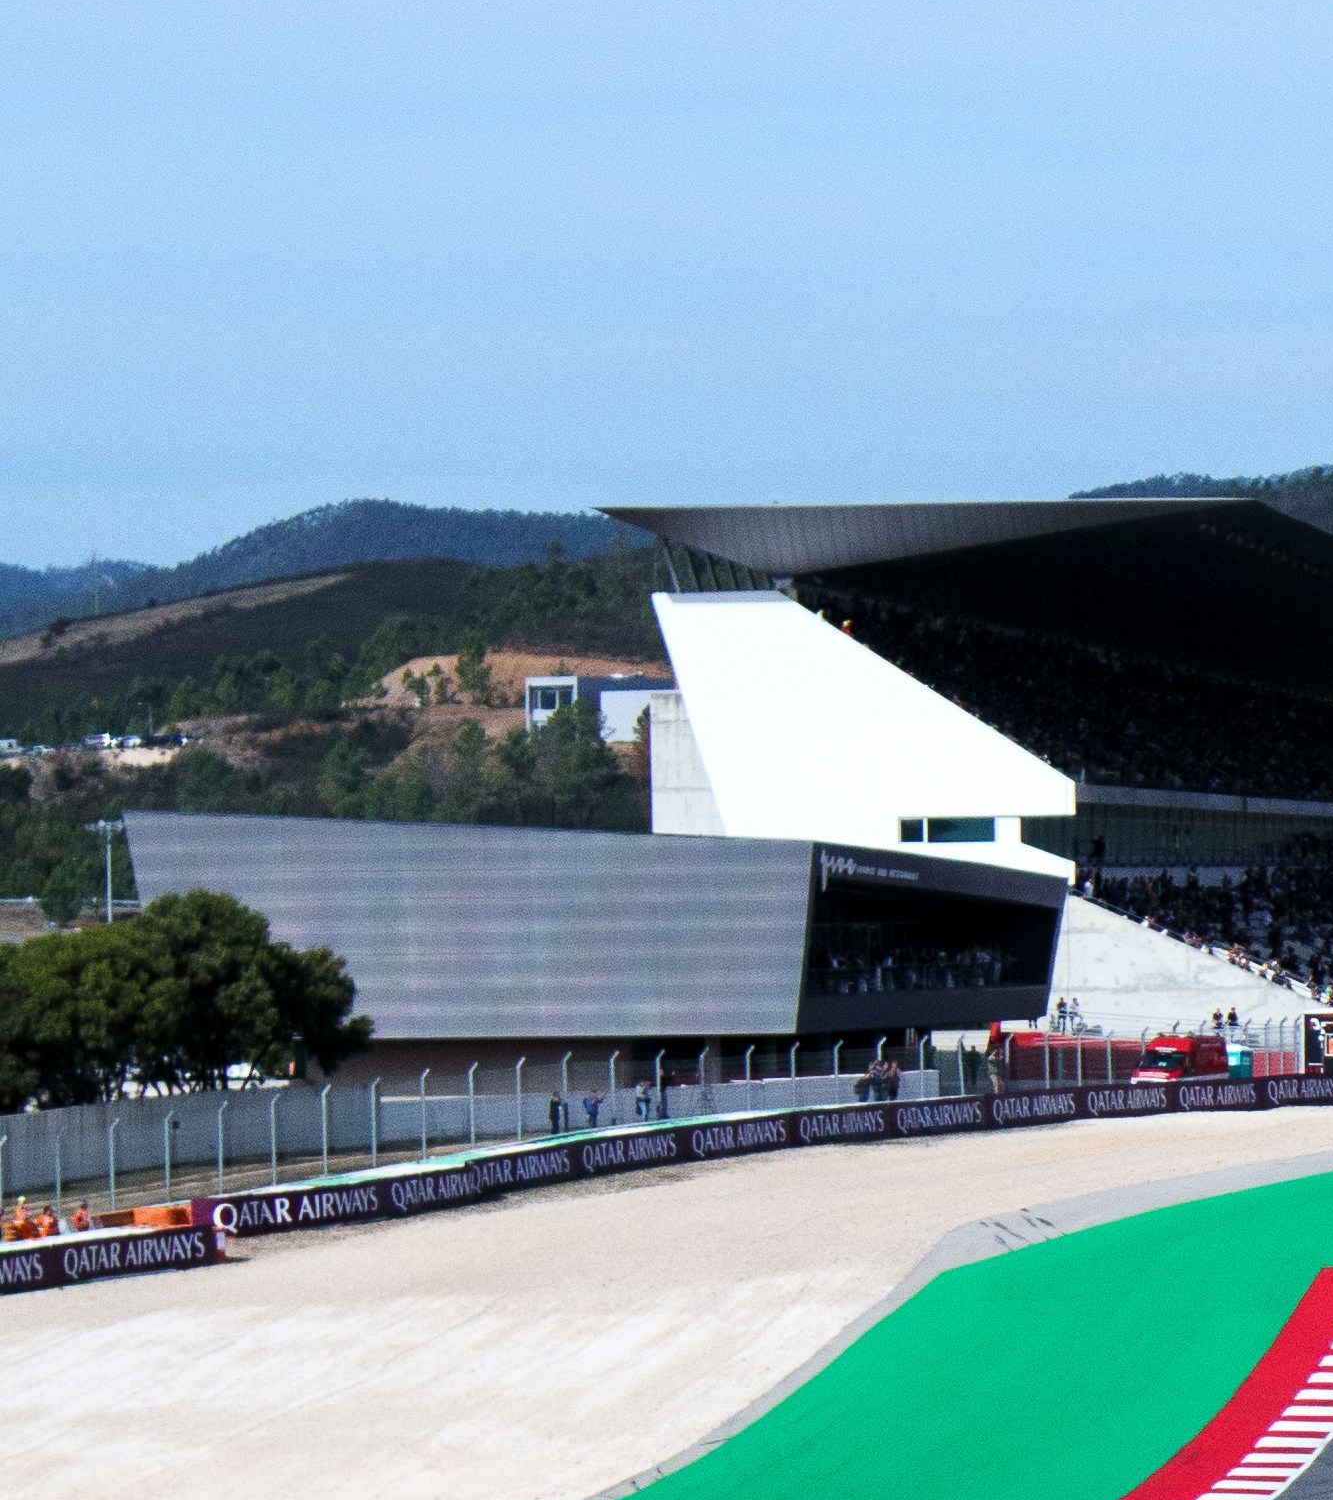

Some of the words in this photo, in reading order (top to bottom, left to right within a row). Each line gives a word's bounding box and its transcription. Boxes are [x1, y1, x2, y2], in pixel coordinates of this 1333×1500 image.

[1087, 1091, 1124, 1116] QATAR
[1127, 1088, 1167, 1109] AIRWAYS
[1178, 1085, 1213, 1110] QATAR
[1216, 1083, 1255, 1105] AIRWAYS
[1267, 1080, 1298, 1103] QATAR
[896, 1106, 929, 1133] QATAR
[931, 1102, 982, 1127] AIRWAYS
[993, 1098, 1028, 1124] QATAR
[1032, 1093, 1075, 1116] AIRWAYS
[692, 1126, 734, 1155] QATAR
[737, 1120, 786, 1147] AIRWAYS
[800, 1114, 839, 1142] QATAR
[840, 1111, 884, 1135] AIRWAYS
[516, 1150, 571, 1184] AIRWAYS
[583, 1140, 624, 1172] QATAR
[628, 1134, 677, 1162] AIRWAYS
[213, 1198, 292, 1234] QATAR
[298, 1186, 378, 1222] AIRWAYS
[391, 1178, 434, 1211] QATAR
[0, 1254, 43, 1284] WAYS
[63, 1244, 121, 1279] QATAR
[125, 1232, 206, 1266] AIRWAYS
